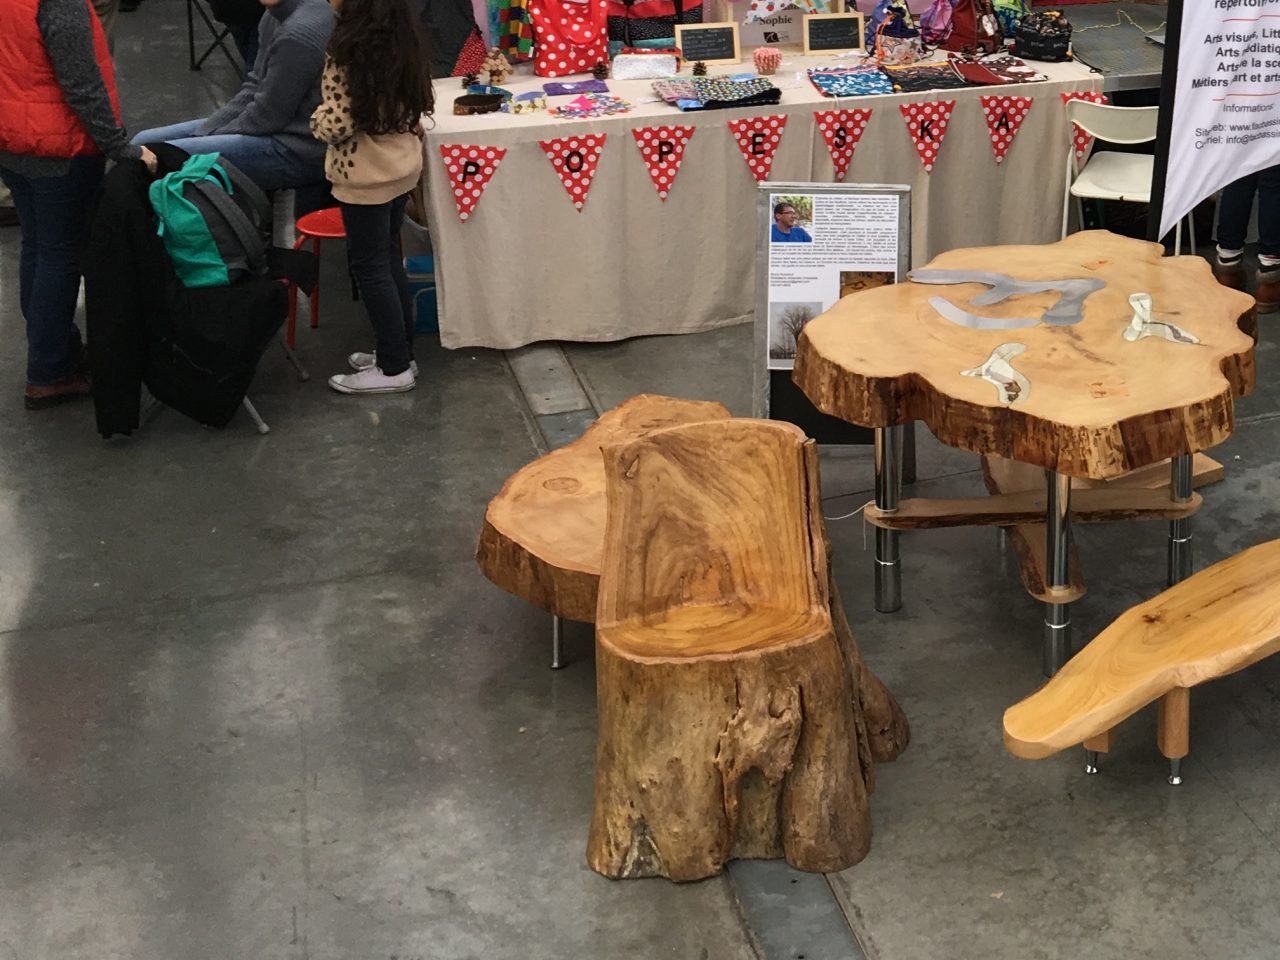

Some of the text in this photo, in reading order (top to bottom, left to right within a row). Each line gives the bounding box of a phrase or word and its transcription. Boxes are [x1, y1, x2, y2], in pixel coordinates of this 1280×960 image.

[760, 13, 793, 27] Sophie
[1204, 34, 1223, 44] Arts
[1216, 47, 1240, 58] Arts
[1217, 61, 1240, 72] Arts
[1251, 57, 1261, 68] la
[1250, 74, 1262, 83] et
[1195, 127, 1211, 138] Sit
